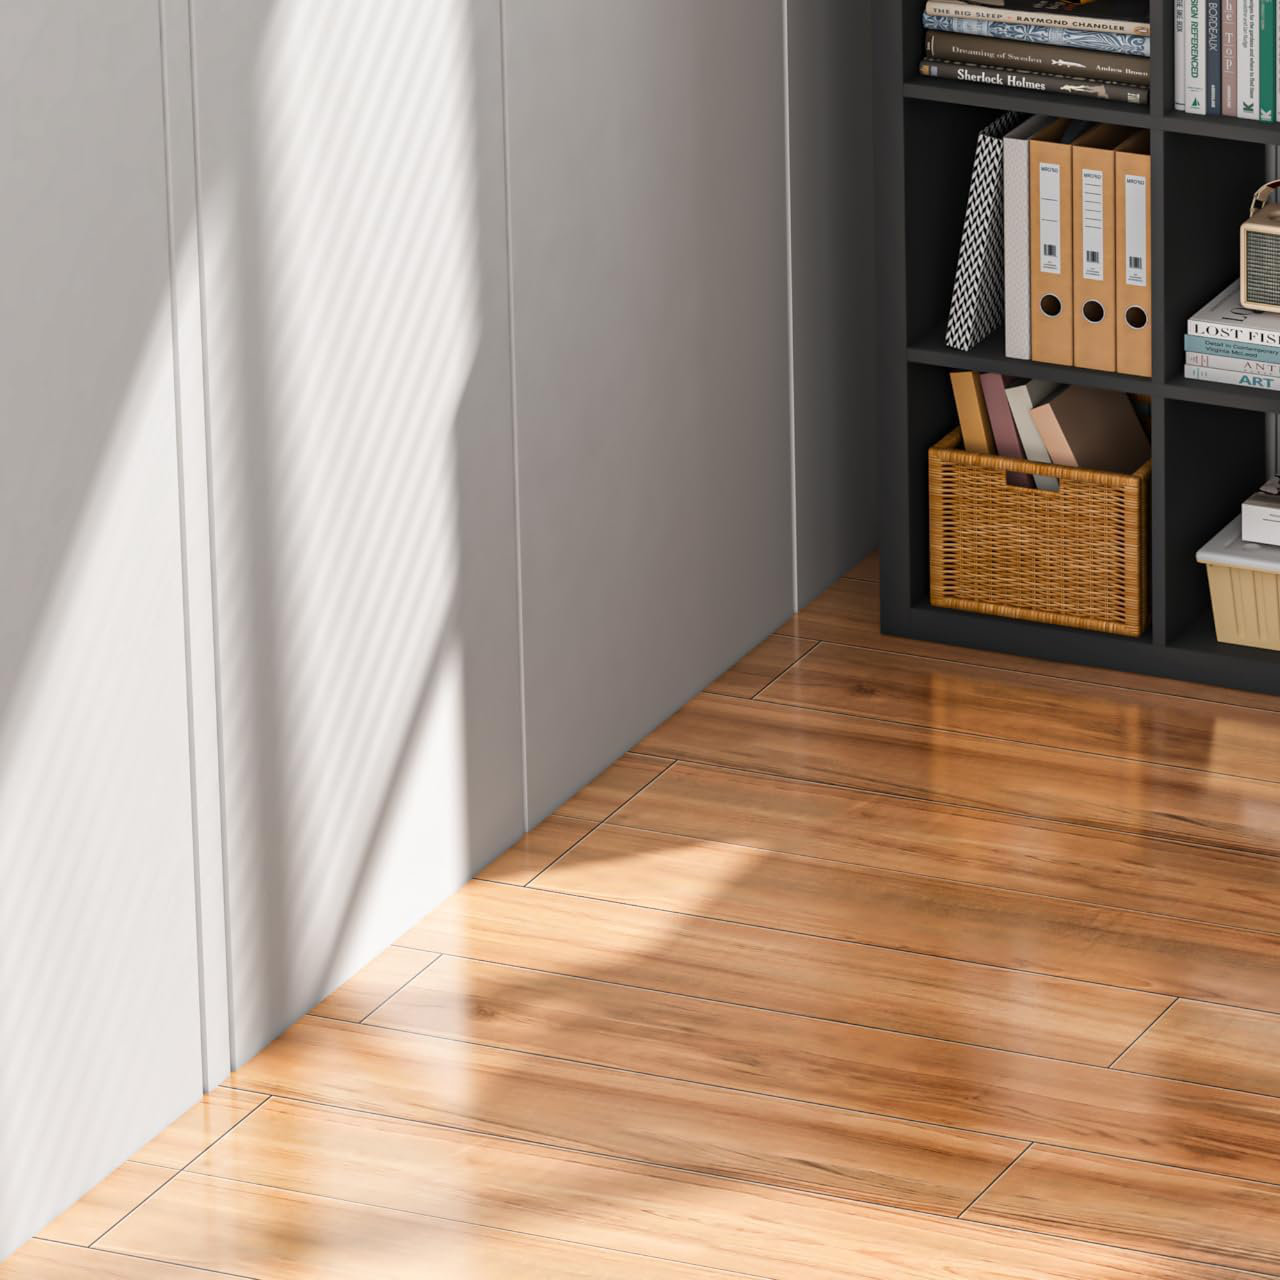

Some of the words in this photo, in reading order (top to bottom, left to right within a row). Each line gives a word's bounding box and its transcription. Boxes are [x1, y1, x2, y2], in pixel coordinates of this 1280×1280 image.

[933, 7, 951, 15] THE
[954, 8, 972, 17] BIG
[975, 11, 1003, 20] SLEEP
[1016, 15, 1068, 26] RAYMOND
[1072, 21, 1125, 32] CHANDLER
[1208, 2, 1218, 51] BORDEAUX
[952, 46, 995, 59] Dreaming
[996, 50, 1006, 59] of
[1007, 52, 1043, 64] Sweden
[1190, 21, 1199, 78] REFERENCED
[1095, 64, 1122, 73] Andrew
[957, 69, 1004, 86] Sherlock
[1007, 75, 1046, 91] Holmes
[1193, 323, 1243, 340] LOST
[1205, 347, 1231, 355] Virginia
[1231, 350, 1258, 358] McLeod
[1233, 344, 1279, 356] Contemporary
[1238, 374, 1274, 388] ART
